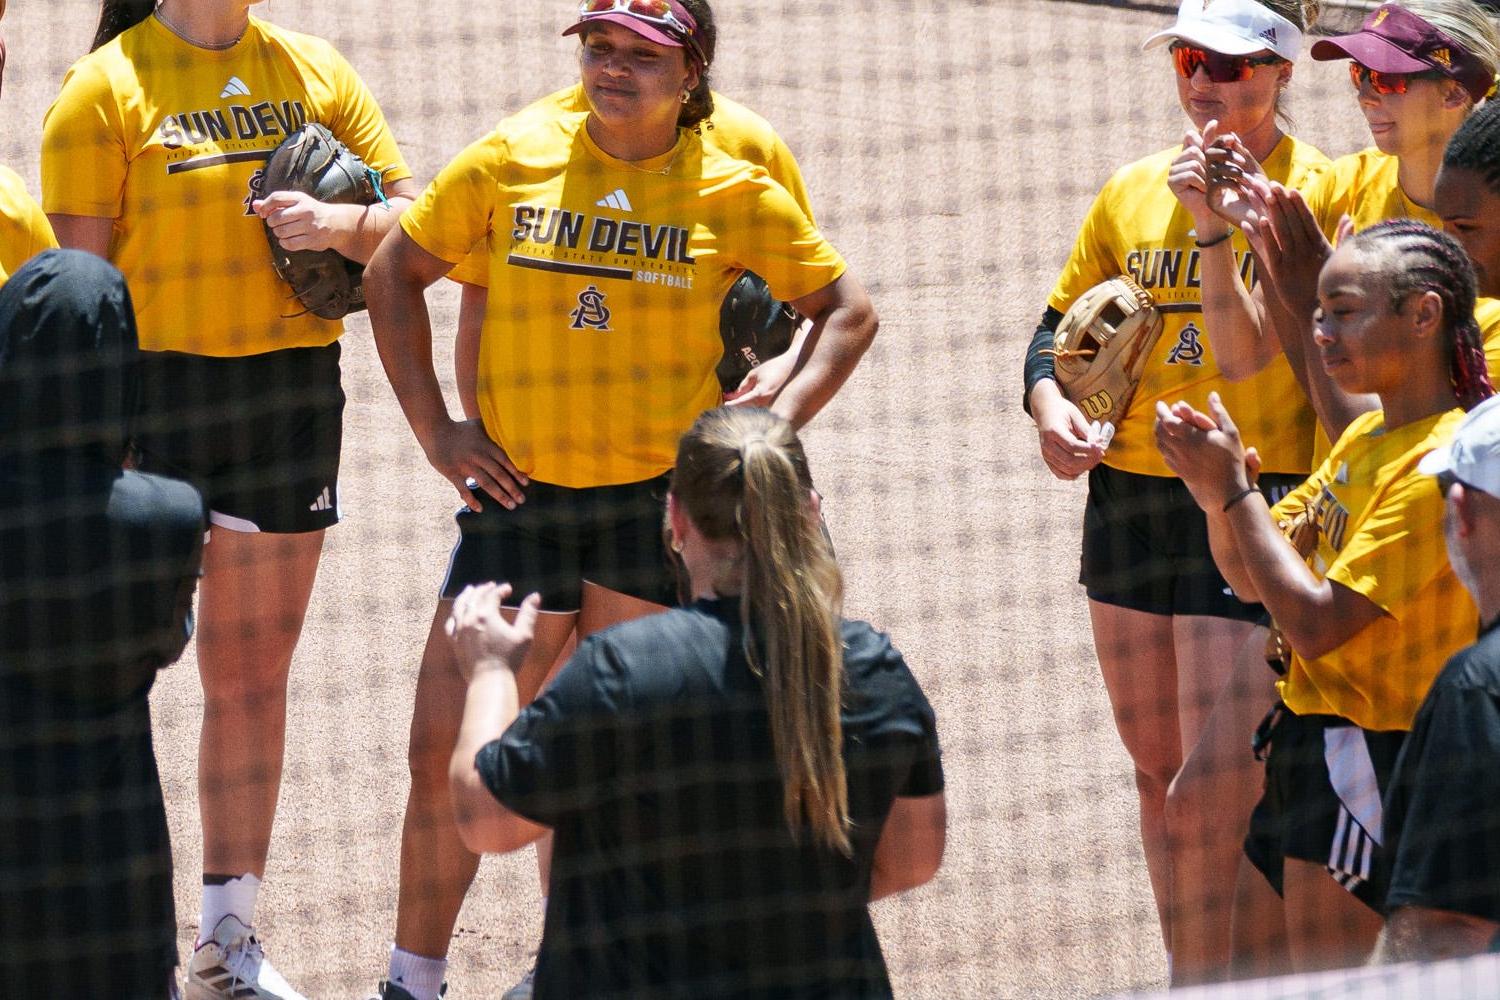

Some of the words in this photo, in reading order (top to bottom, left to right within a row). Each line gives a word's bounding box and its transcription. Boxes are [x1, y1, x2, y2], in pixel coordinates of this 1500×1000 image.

[159, 109, 233, 151] SUN
[512, 204, 585, 250] SUN
[587, 215, 698, 266] DEVIL
[635, 269, 694, 291] SOFTBALL
[1127, 249, 1183, 289] SUN
